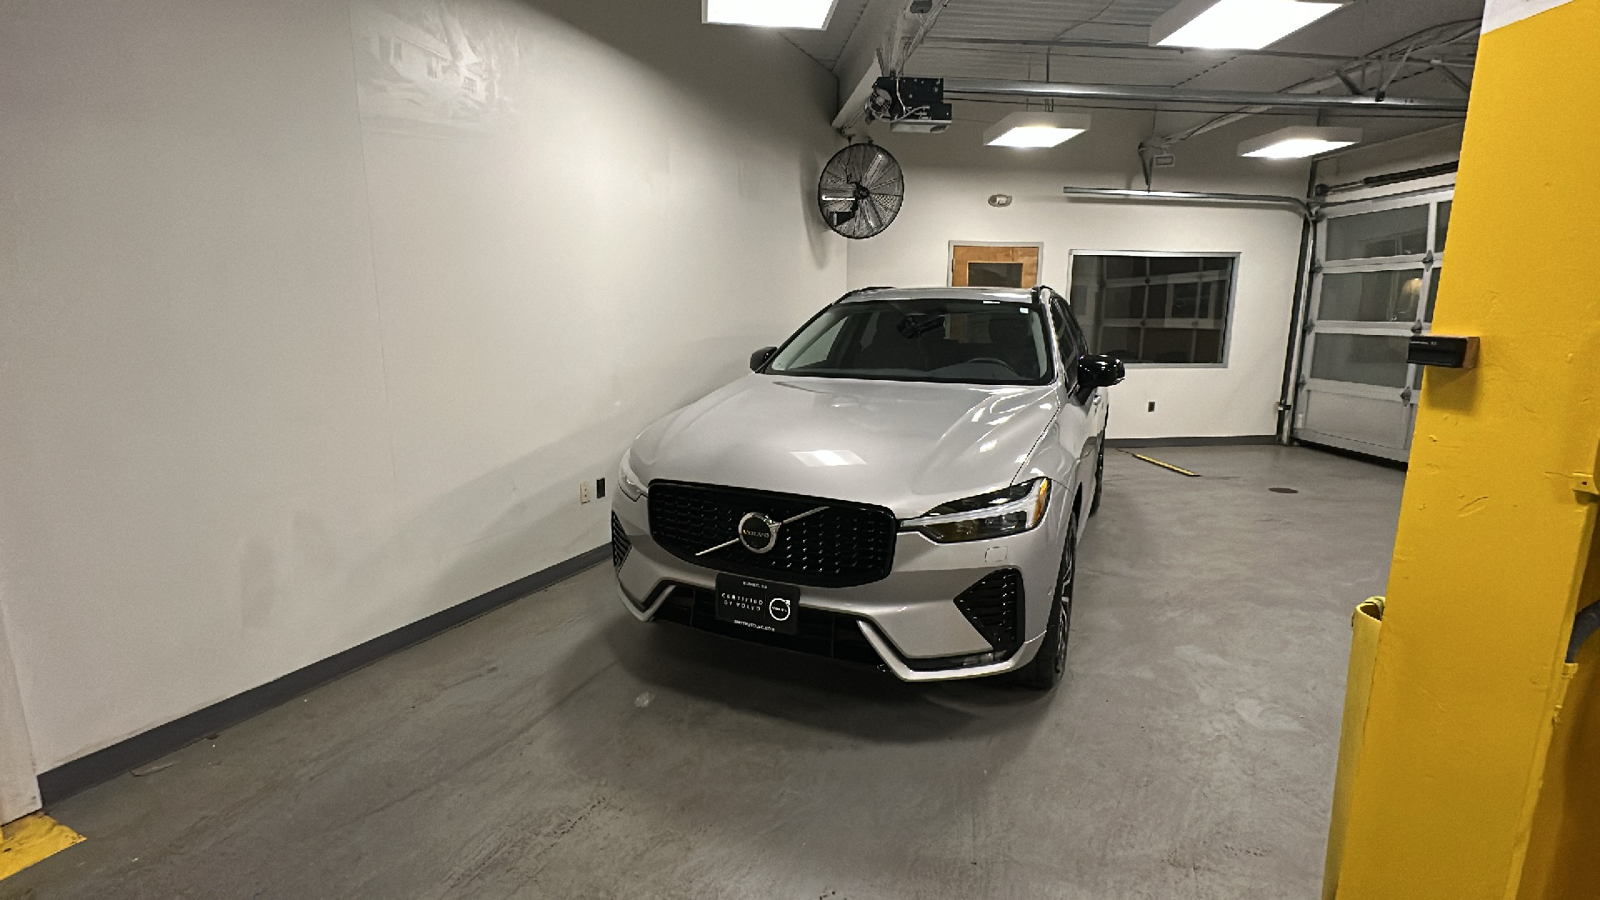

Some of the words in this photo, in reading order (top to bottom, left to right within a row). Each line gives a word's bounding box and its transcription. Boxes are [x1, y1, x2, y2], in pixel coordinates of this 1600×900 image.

[743, 529, 769, 538] VOLVO
[721, 592, 763, 606] CERTIFIED
[736, 602, 761, 611] VOLVO
